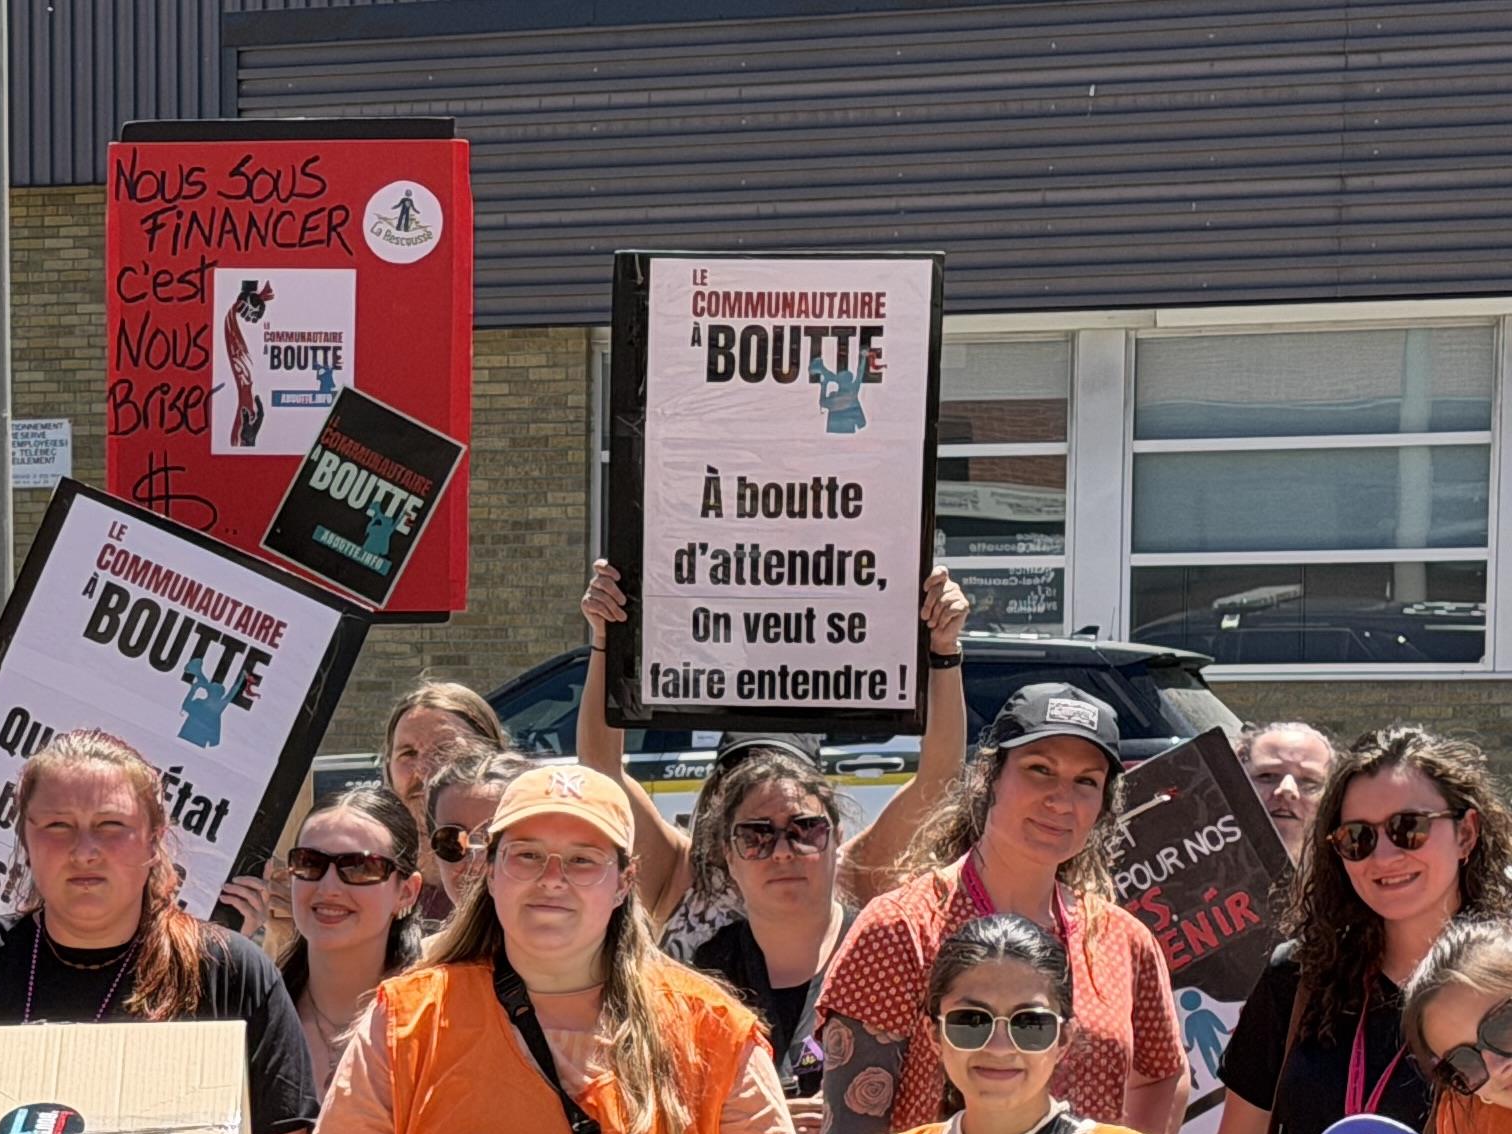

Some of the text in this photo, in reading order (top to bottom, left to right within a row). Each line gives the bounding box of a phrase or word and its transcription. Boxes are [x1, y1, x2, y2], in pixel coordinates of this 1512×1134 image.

[217, 154, 327, 204] SOUS
[692, 269, 708, 286] LE
[691, 290, 887, 319] COMMUNAUTAIRE
[263, 331, 343, 343] COMMUNAUTAIRE
[270, 345, 343, 371] BOUTTE
[691, 321, 884, 384] À BOUTTE
[321, 428, 434, 497] COMMUNAUTAIRE
[308, 450, 425, 535] BOUTTE
[700, 464, 863, 520] À boutte
[108, 521, 128, 542] LE
[674, 543, 888, 591] d'attendre,
[96, 543, 288, 649] COMMUNAUTAIRE
[81, 571, 272, 712] À BOUTTE
[692, 606, 867, 645] On veut se
[650, 661, 726, 701] faire
[737, 664, 888, 701] entendre
[663, 763, 718, 778] Sûret
[1114, 814, 1242, 900] POUR NOS
